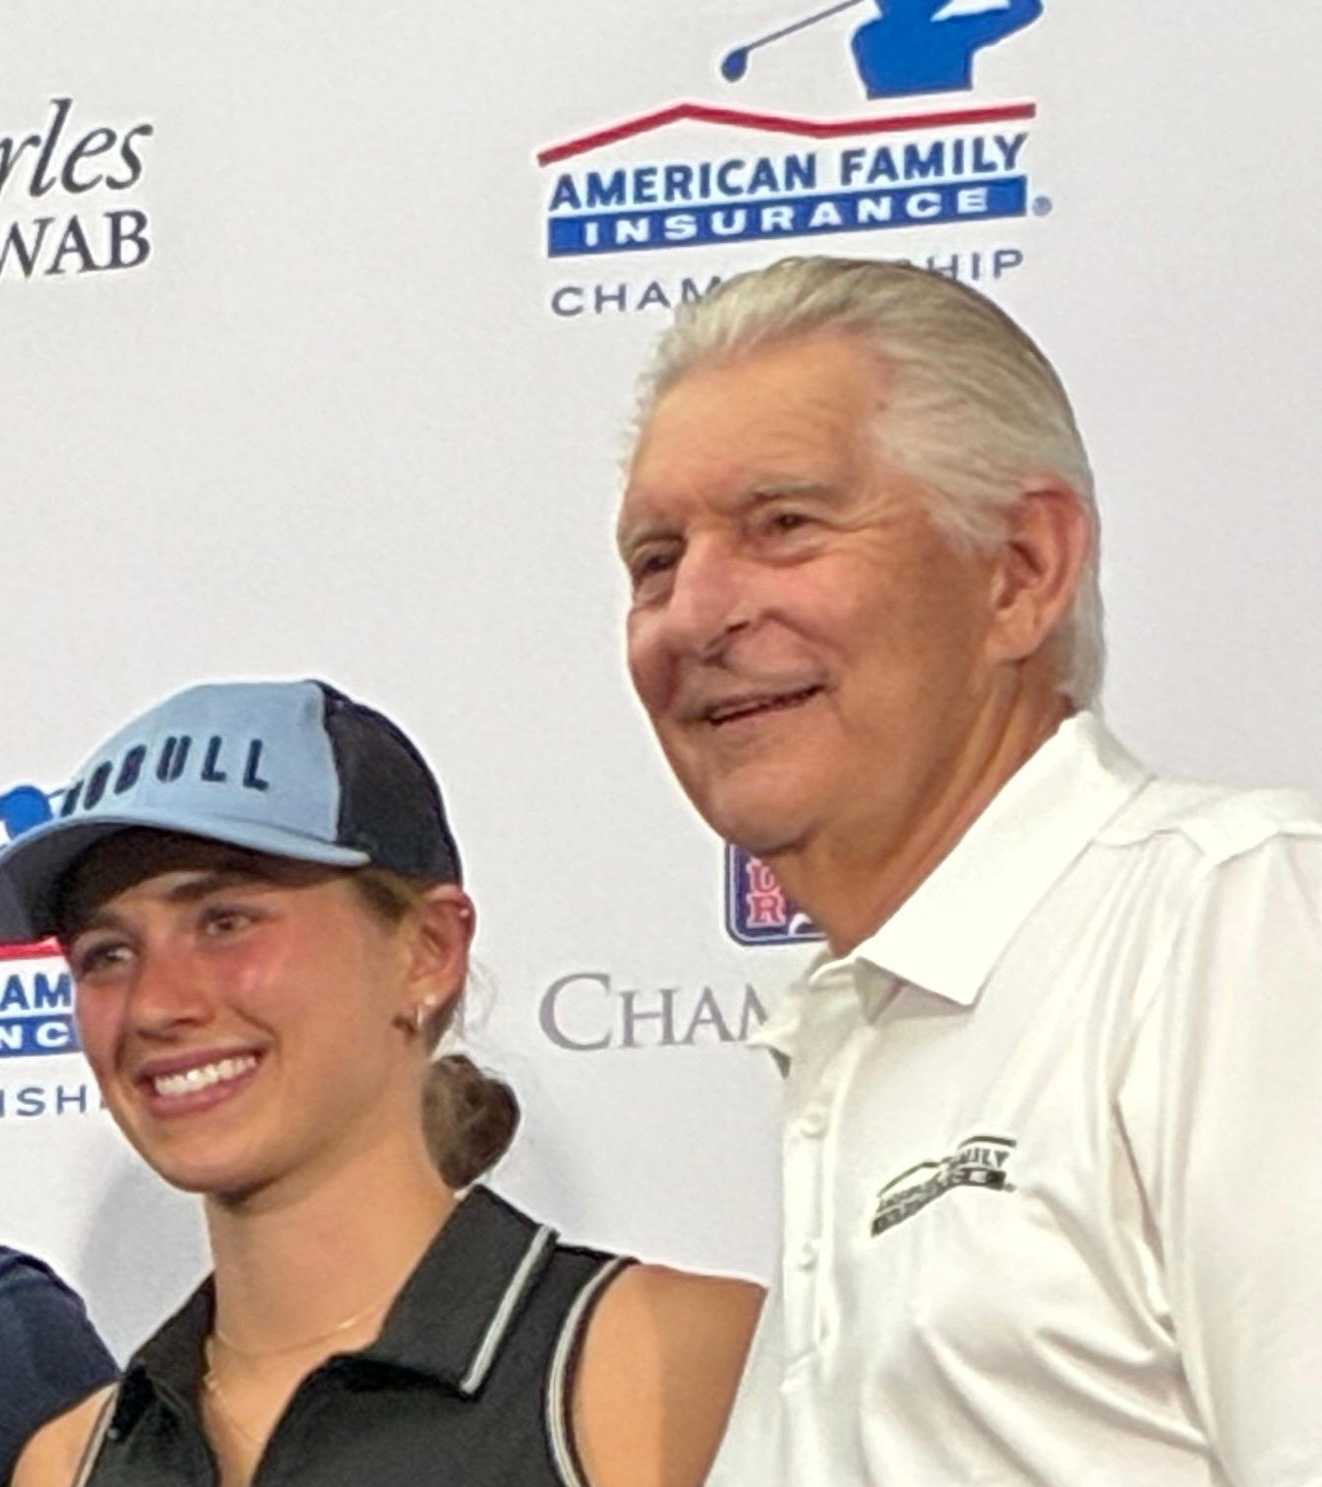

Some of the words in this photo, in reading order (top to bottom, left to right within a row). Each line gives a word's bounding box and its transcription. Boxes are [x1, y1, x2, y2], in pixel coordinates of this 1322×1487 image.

[548, 152, 817, 212] AMERICAN
[840, 133, 1028, 187] FAMILY
[583, 187, 989, 247] INSURANCE
